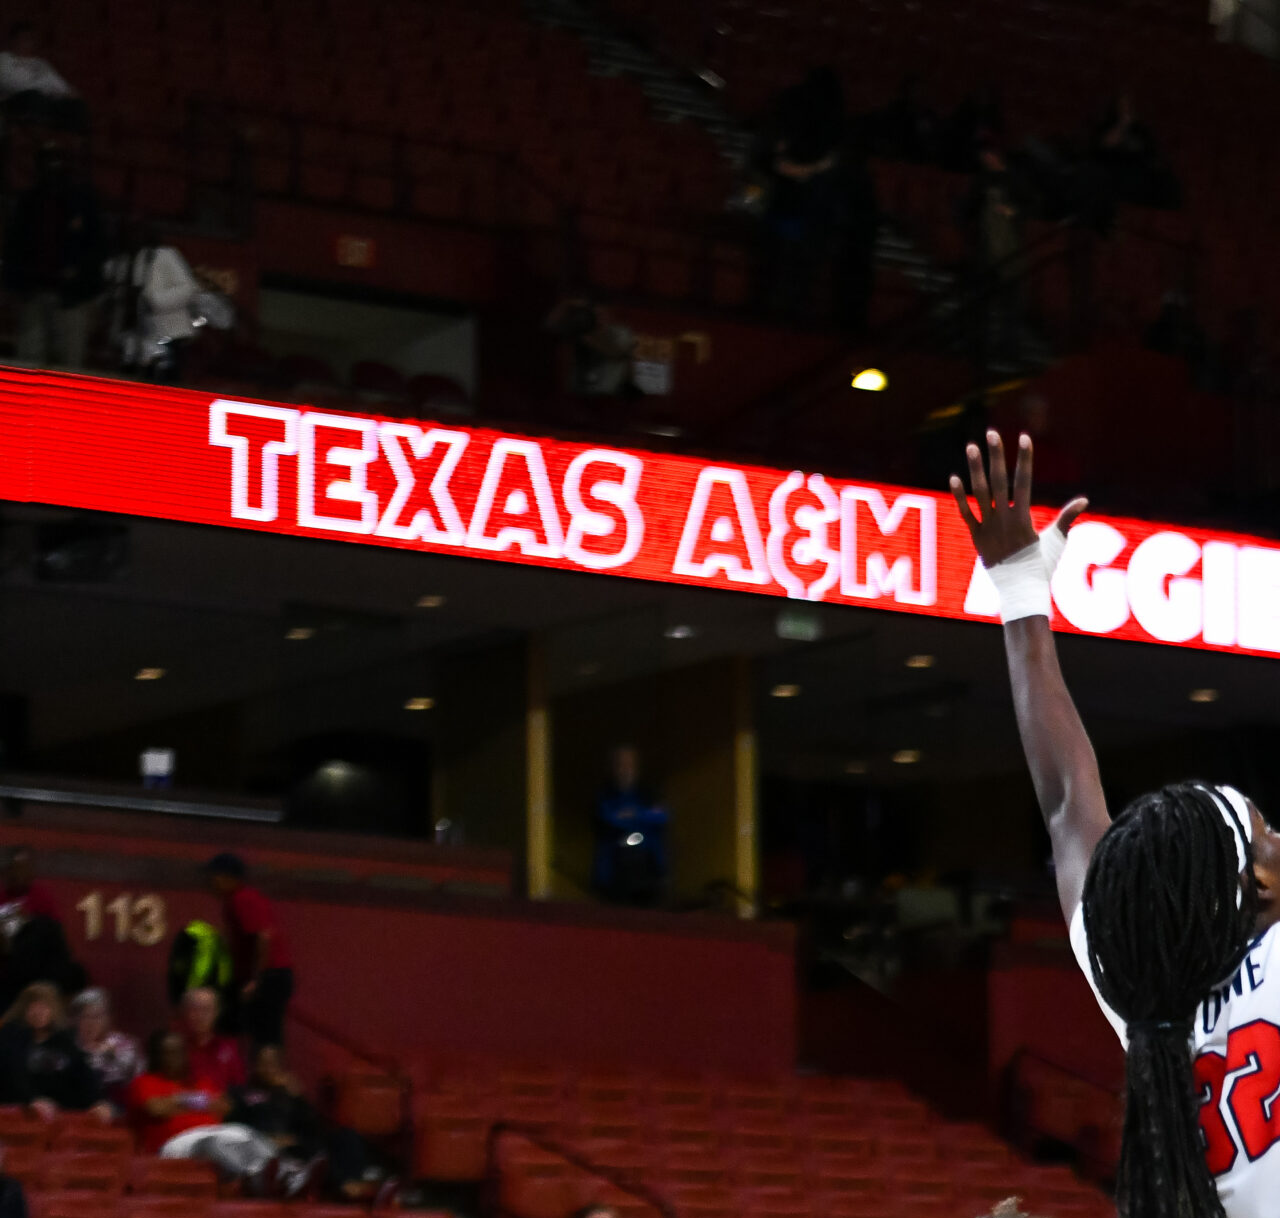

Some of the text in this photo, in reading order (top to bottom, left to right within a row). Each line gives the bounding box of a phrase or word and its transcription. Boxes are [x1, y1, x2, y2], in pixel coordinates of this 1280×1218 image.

[209, 399, 645, 570] TEXAS
[672, 466, 936, 602] A&M
[75, 893, 166, 946] 113
